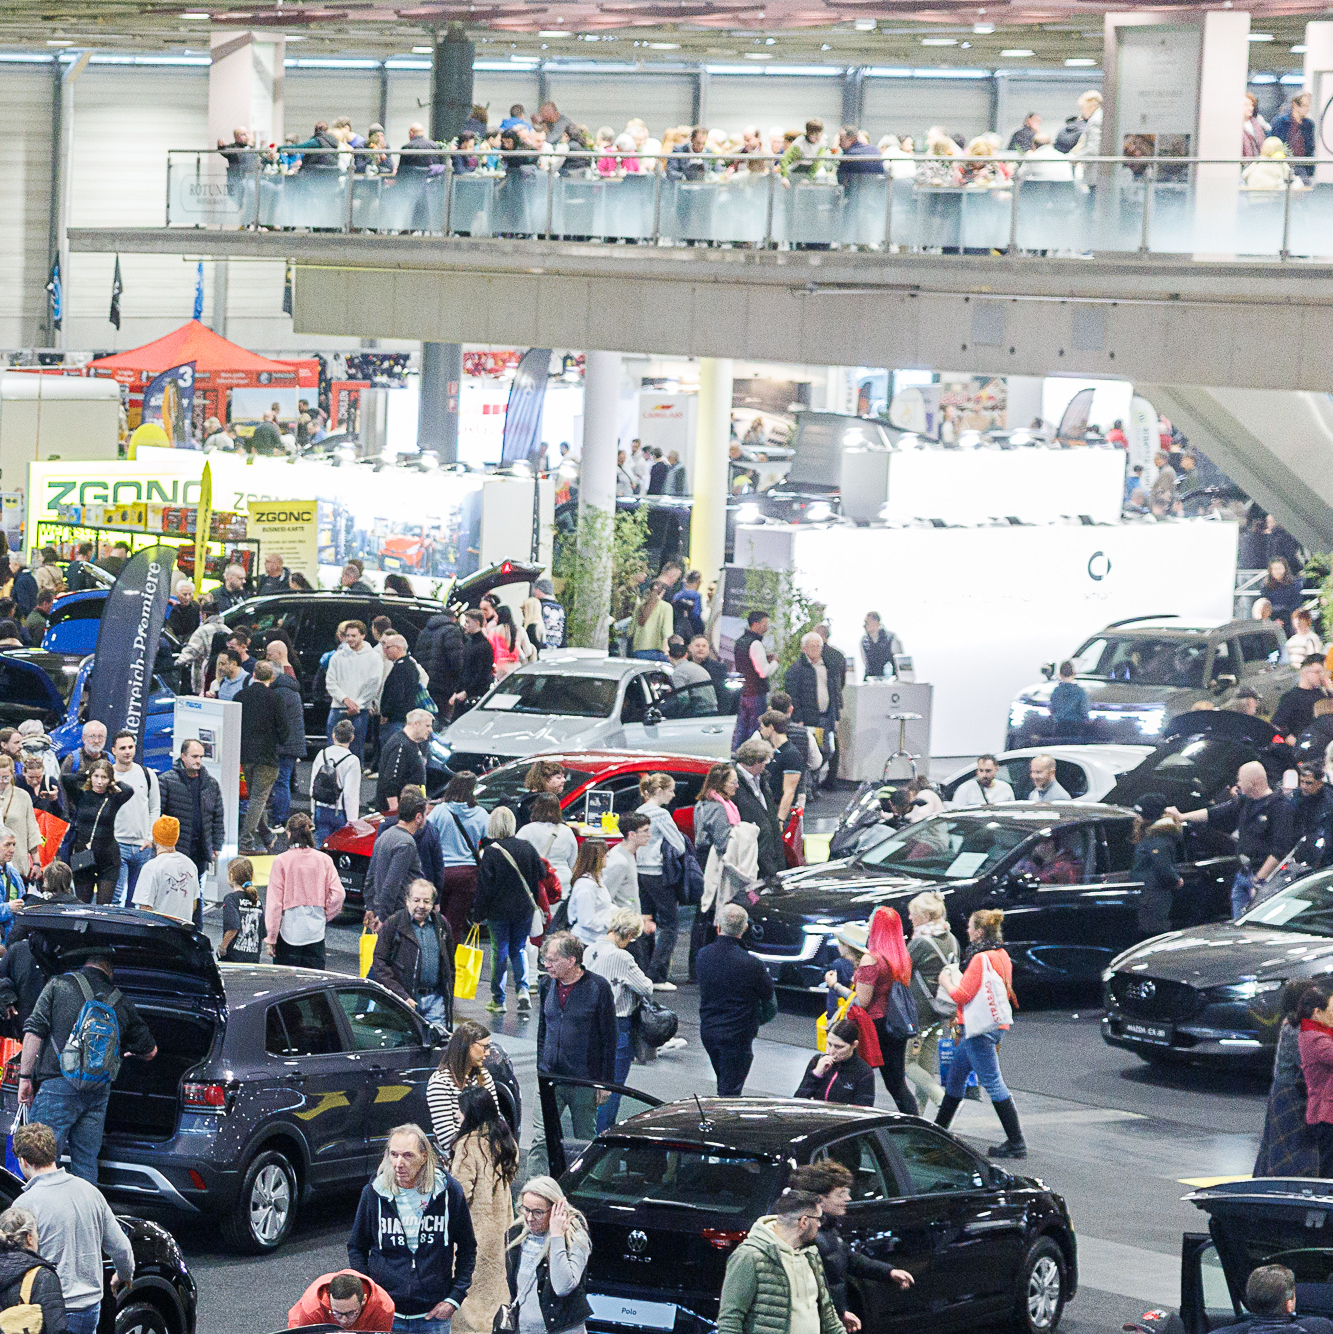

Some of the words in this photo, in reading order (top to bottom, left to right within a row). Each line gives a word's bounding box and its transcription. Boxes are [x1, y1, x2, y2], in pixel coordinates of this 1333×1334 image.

[178, 366, 193, 387] 3
[47, 480, 203, 510] ZGONC
[255, 511, 312, 522] ZGONC
[985, 979, 1001, 1024] STRABAG
[389, 1236, 405, 1247] 18
[419, 1233, 434, 1245] 85
[621, 1306, 637, 1316] Polo
